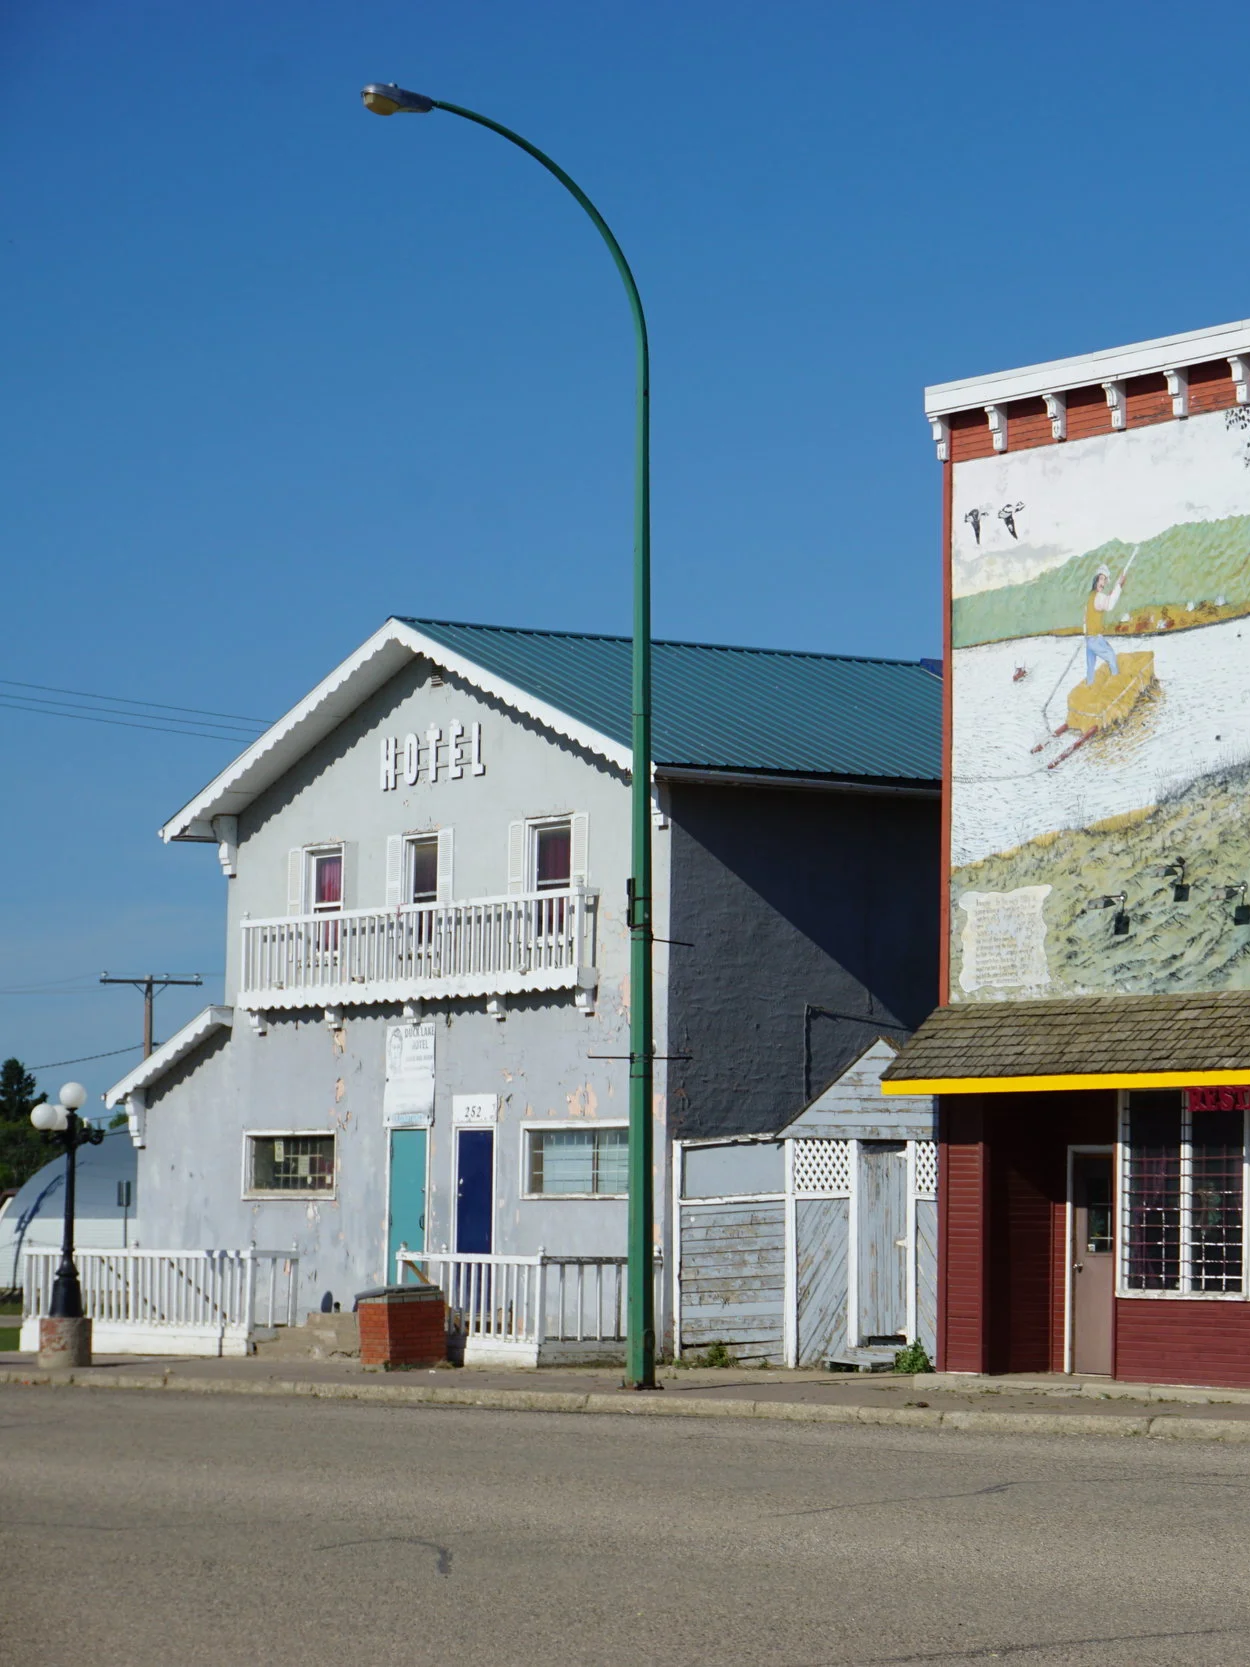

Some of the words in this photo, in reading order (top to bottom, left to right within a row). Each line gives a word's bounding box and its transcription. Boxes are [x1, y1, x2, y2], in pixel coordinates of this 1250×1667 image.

[380, 720, 485, 791] HOTEL
[404, 1026, 420, 1038] DUCK
[420, 1025, 435, 1037] LAKE
[464, 1105, 482, 1118] 252
